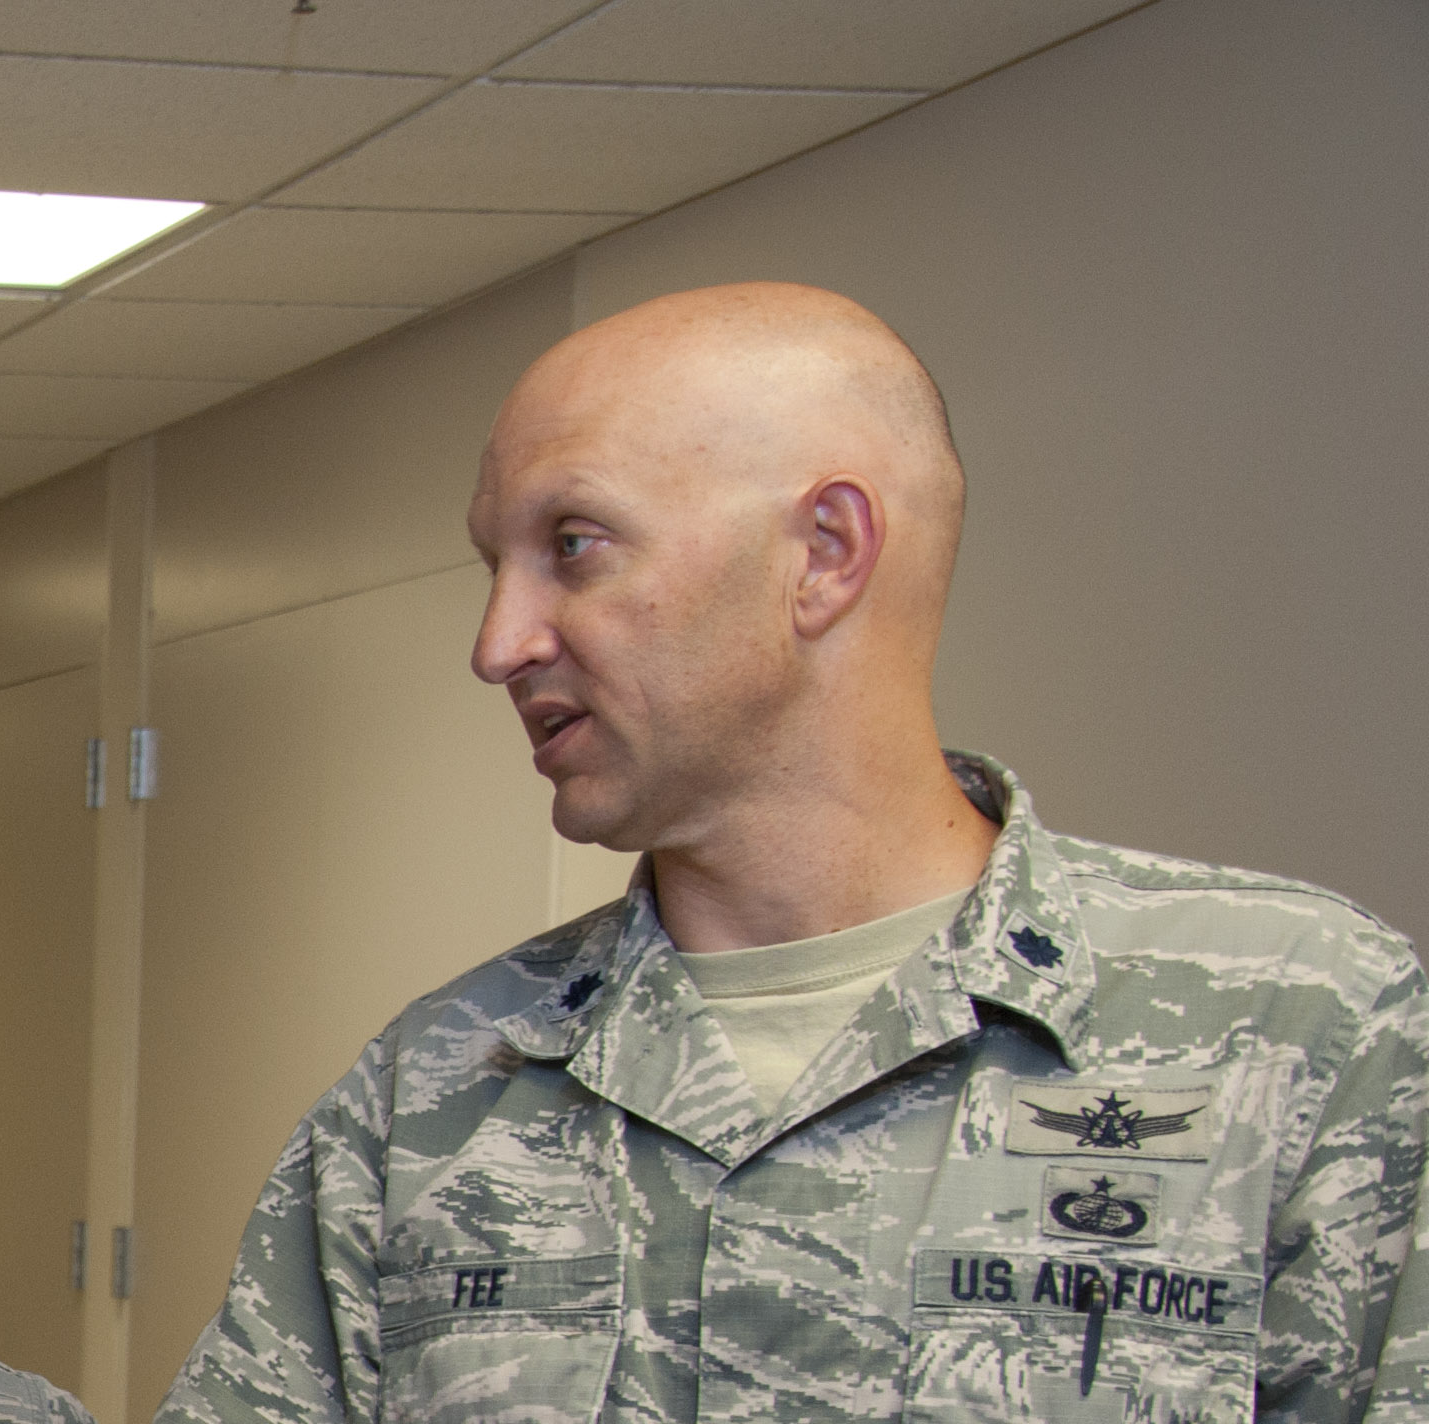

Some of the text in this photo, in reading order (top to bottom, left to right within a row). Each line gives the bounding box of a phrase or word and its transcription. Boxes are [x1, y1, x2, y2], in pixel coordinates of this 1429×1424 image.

[452, 1267, 508, 1308] FEE
[950, 1257, 1017, 1302] U.S.
[1112, 1265, 1229, 1325] FORCE
